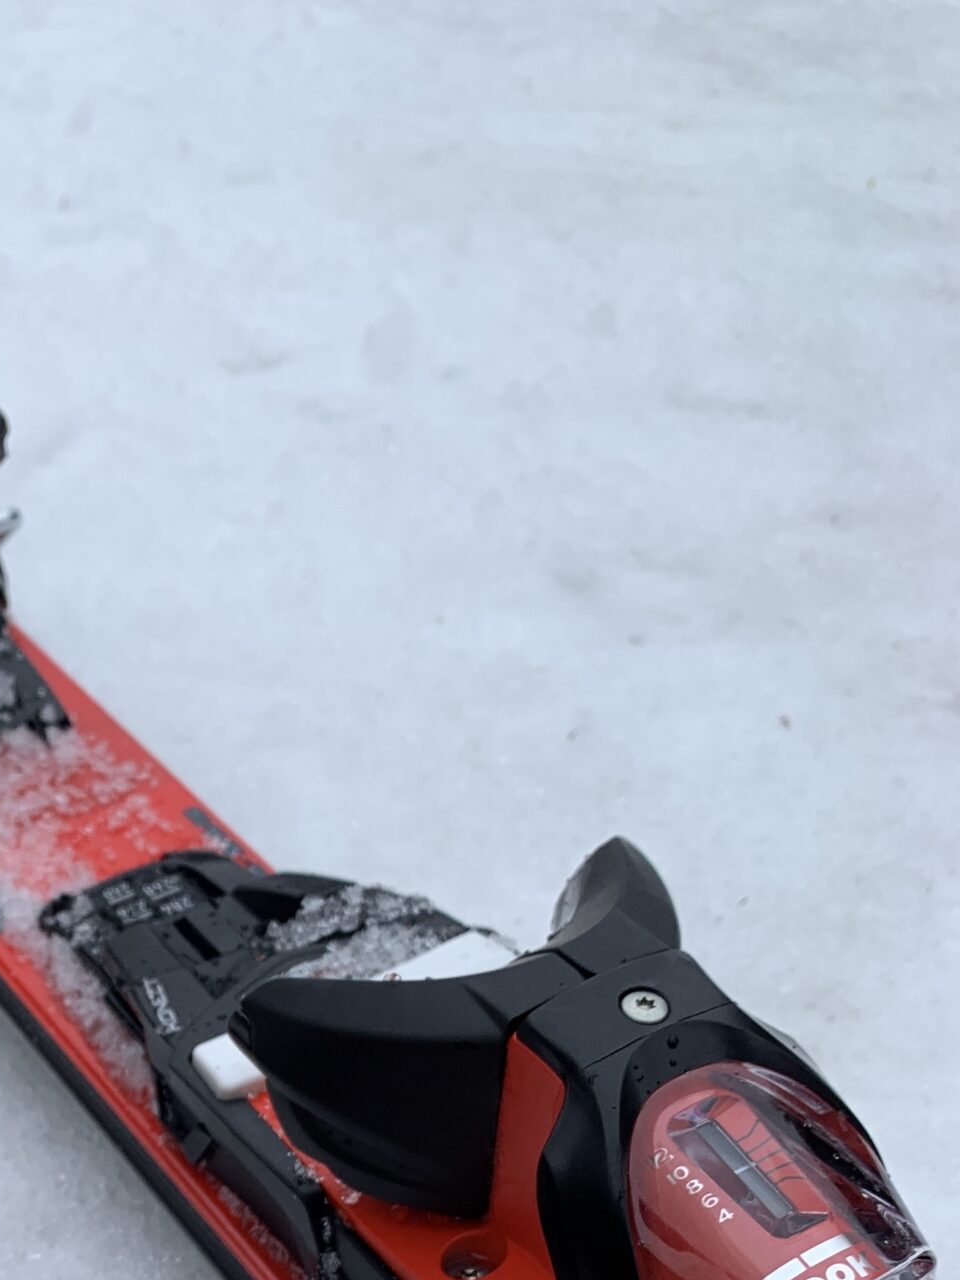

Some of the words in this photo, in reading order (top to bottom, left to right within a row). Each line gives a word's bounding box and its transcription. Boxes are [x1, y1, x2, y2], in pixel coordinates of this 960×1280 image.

[666, 1165, 689, 1185] 10
[685, 1179, 704, 1195] 8
[701, 1193, 719, 1208] 6
[718, 1207, 734, 1224] 4
